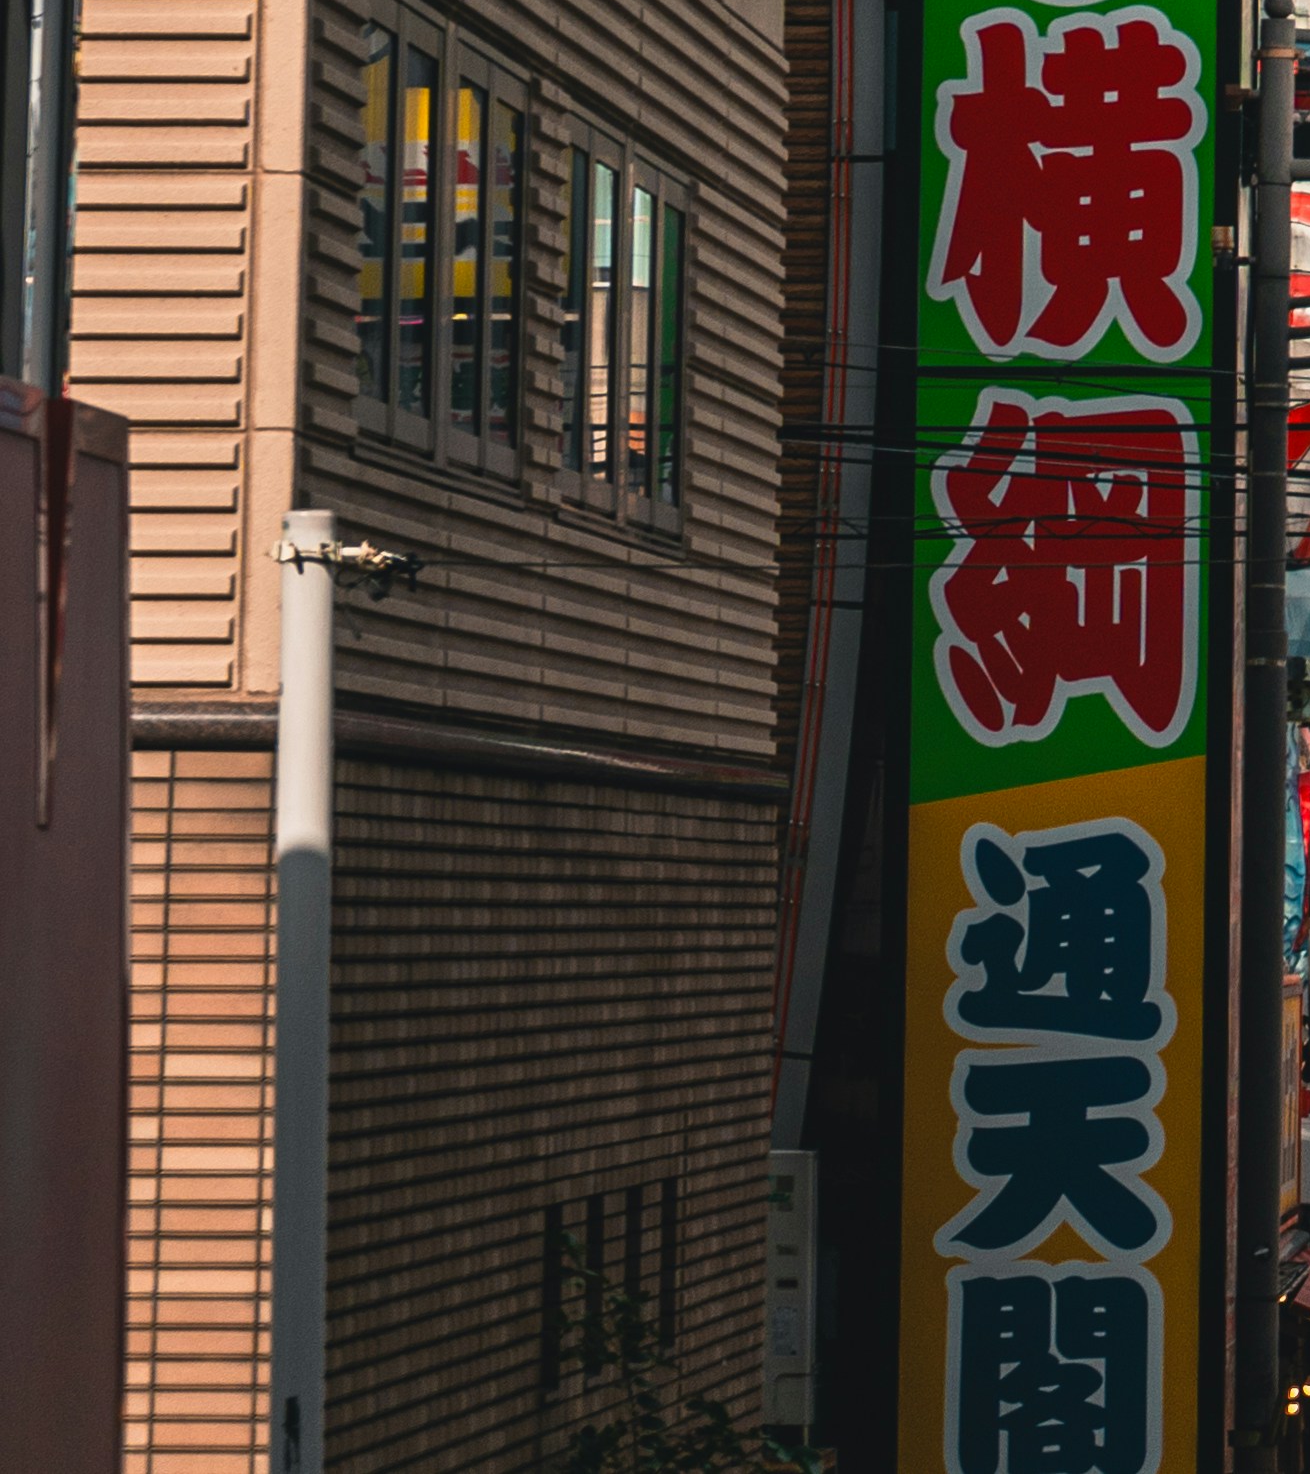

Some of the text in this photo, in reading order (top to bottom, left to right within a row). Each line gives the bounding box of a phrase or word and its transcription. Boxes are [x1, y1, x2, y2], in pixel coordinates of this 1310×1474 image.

[945, 10, 1197, 742] 横綱
[952, 824, 1165, 1474] 通天閣
